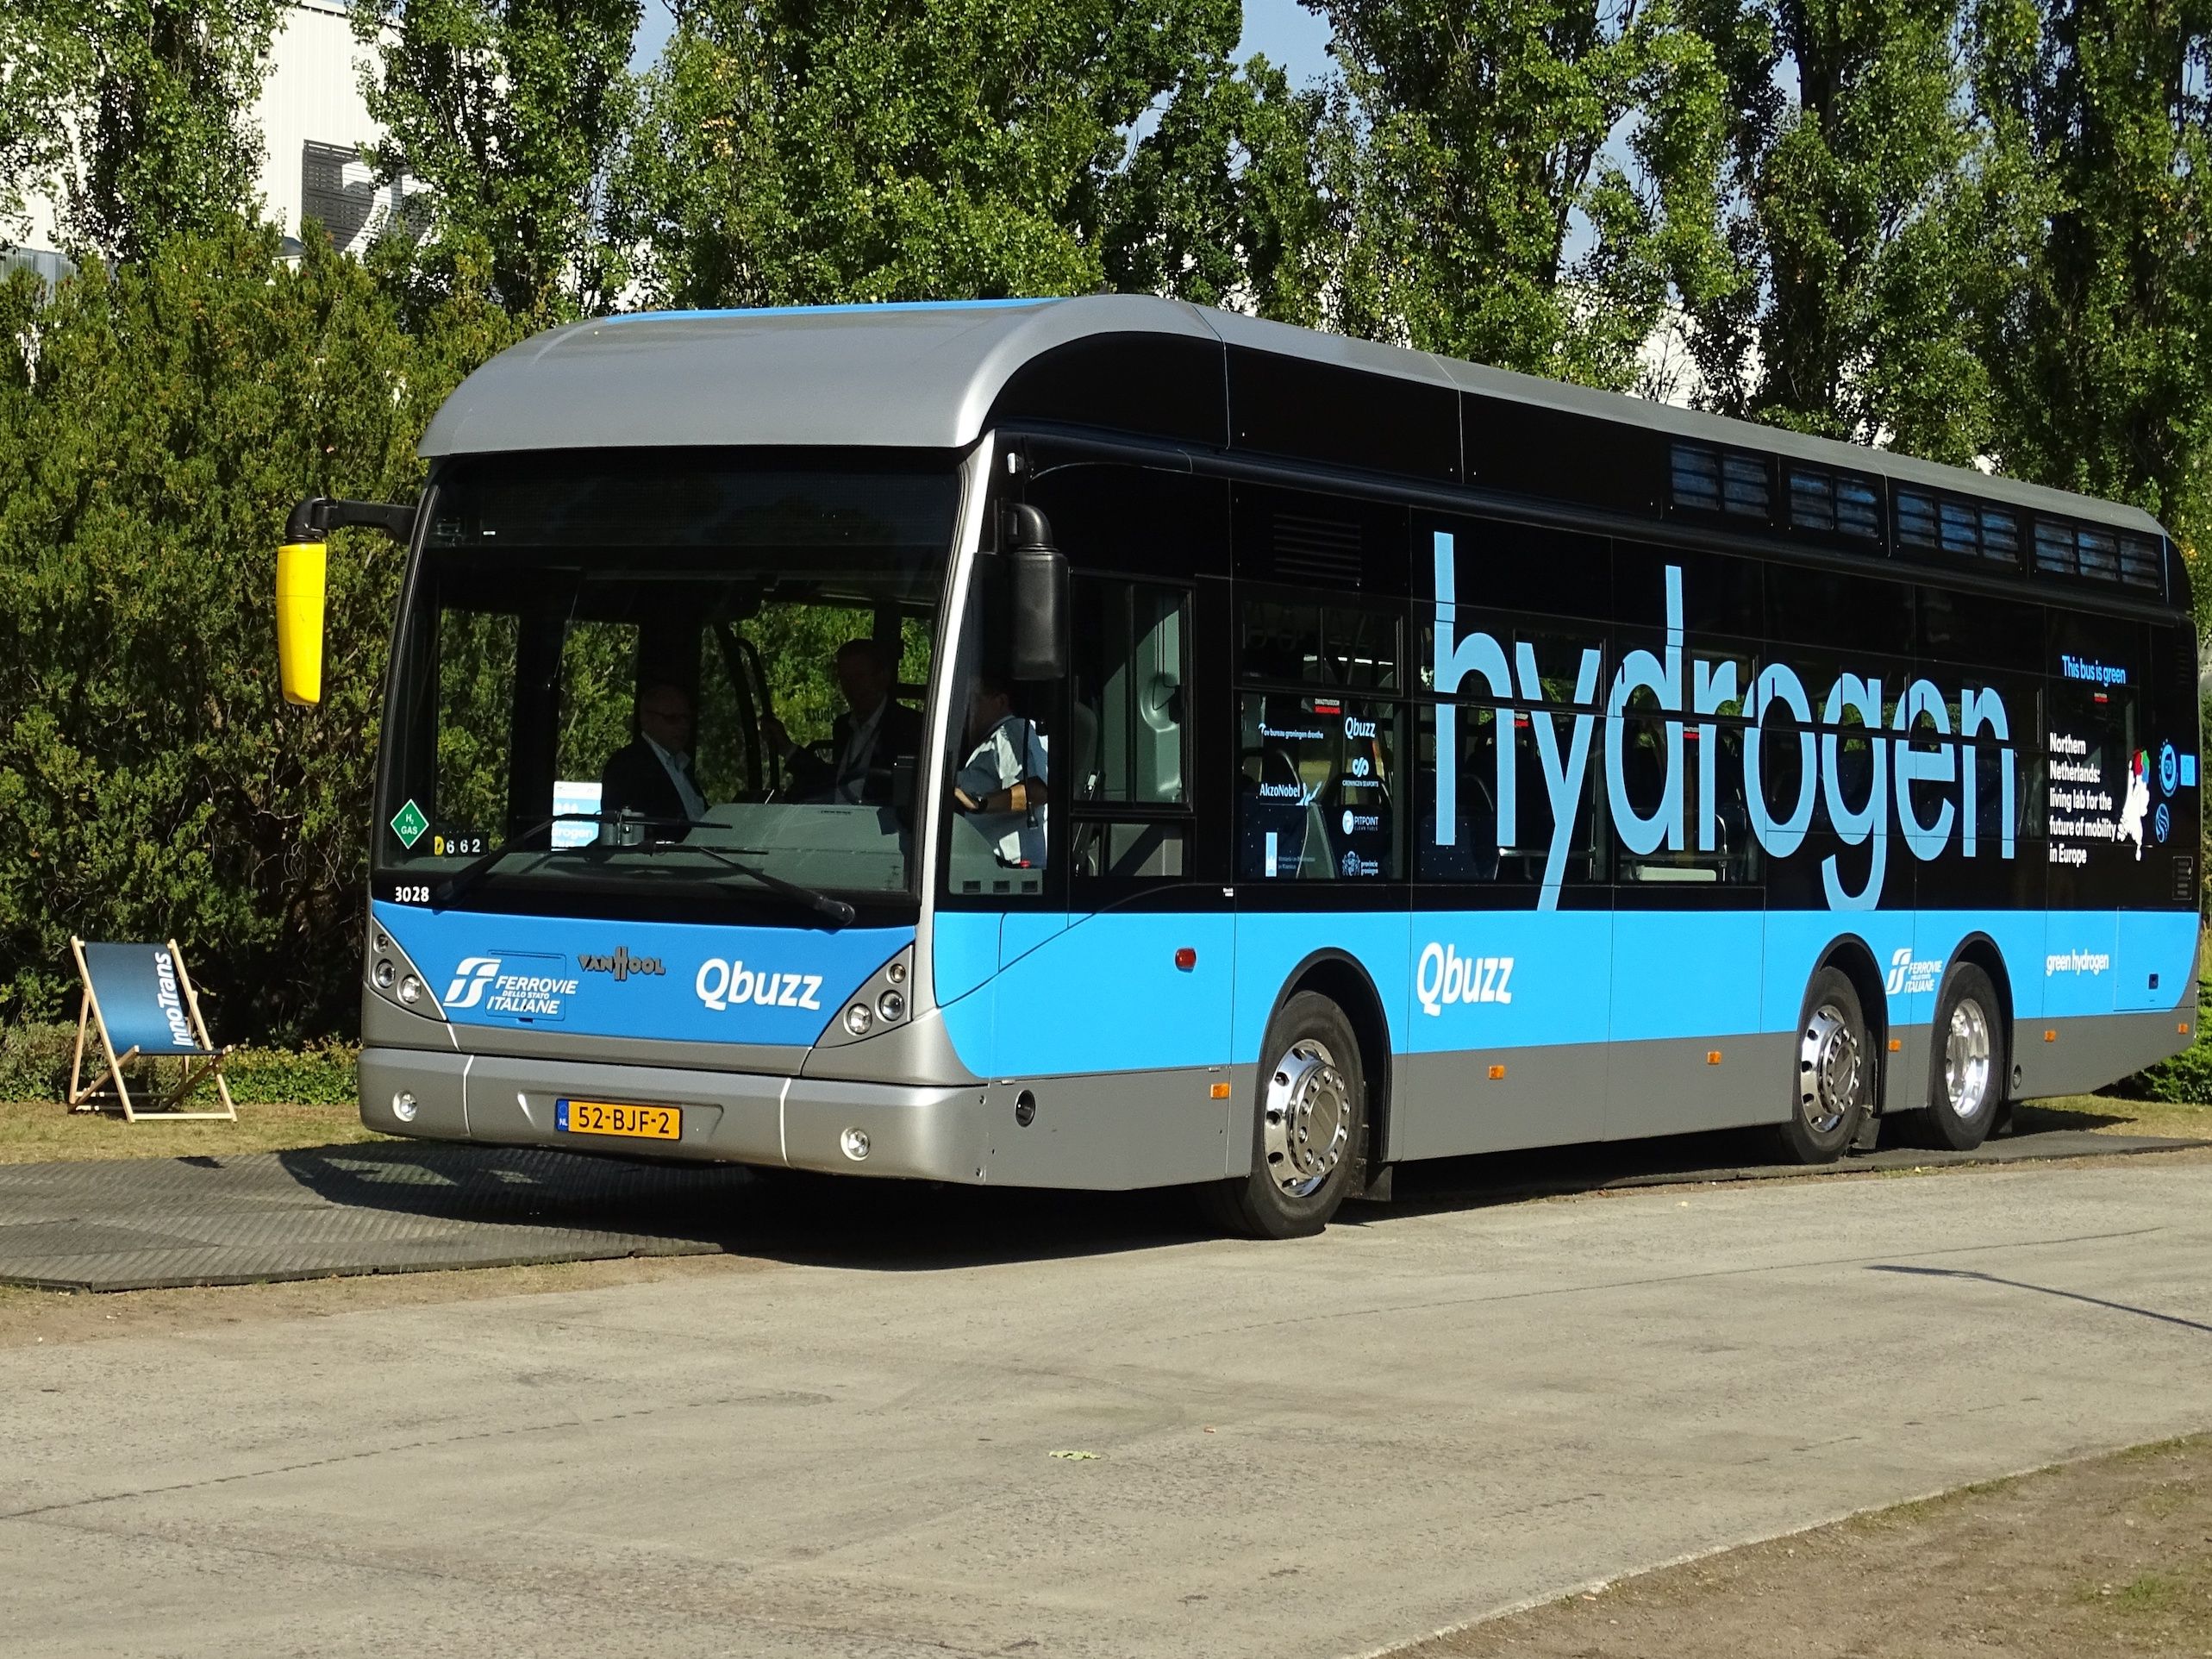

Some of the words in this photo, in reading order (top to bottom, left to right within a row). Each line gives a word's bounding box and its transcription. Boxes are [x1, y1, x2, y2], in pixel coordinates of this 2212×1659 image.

[2062, 655, 2079, 679] This
[2080, 658, 2095, 680] bus
[2096, 660, 2103, 681] is
[2103, 667, 2126, 687] green
[1345, 717, 1376, 740] Qbuzz
[1434, 531, 2015, 911] hydrogen
[2050, 732, 2086, 755] Northern
[2049, 760, 2101, 783] Netherlands:
[1259, 783, 1301, 798] AkzoNobel
[2050, 787, 2071, 813] living
[2072, 789, 2085, 810] lab
[2086, 790, 2098, 810] for
[2099, 791, 2112, 811] the
[401, 825, 418, 836] GAS
[1354, 816, 1378, 825] PITPOINT
[2049, 815, 2074, 836] future
[2075, 817, 2084, 836] of
[2084, 817, 2116, 842] mobility
[2049, 842, 2058, 862] in
[2059, 843, 2087, 867] Europe
[395, 886, 429, 902] 3028
[1908, 960, 1942, 974] FERROVIE
[2046, 955, 2071, 977] green
[2071, 948, 2109, 976] hydrogen
[495, 975, 578, 994] FERROVIE
[696, 958, 823, 1011] Qbuzz
[1416, 942, 1515, 1017] Qbuzz
[1903, 980, 1934, 993] ITALIANE
[154, 952, 195, 1047] InnoTrans
[485, 996, 560, 1015] ITALIANE
[503, 990, 526, 999] DELLO
[527, 991, 550, 999] STATO
[578, 1106, 670, 1134] 52-BJF-2
